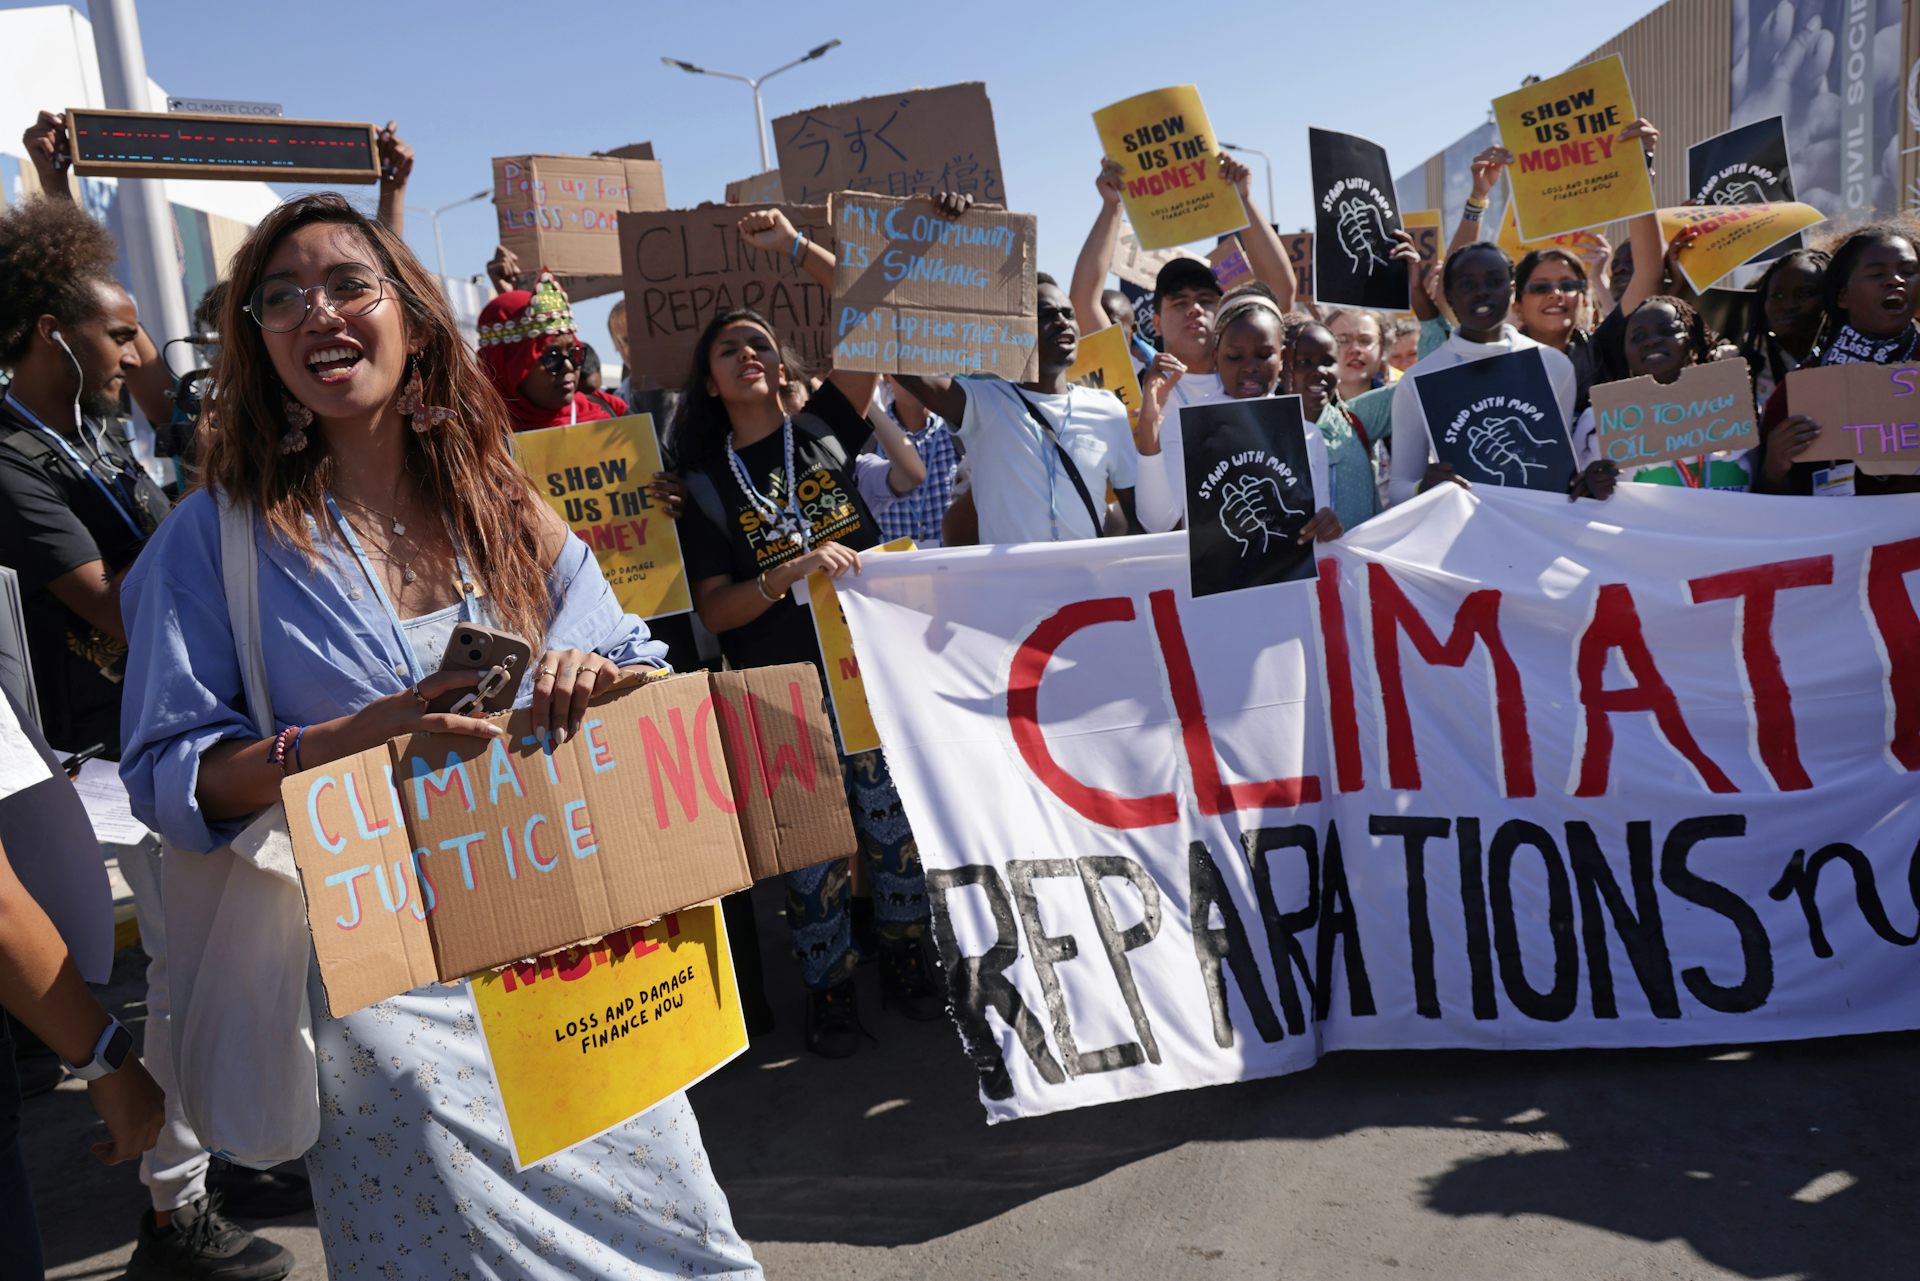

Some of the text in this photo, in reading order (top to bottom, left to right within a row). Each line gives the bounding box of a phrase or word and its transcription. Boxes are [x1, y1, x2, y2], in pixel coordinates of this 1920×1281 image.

[187, 102, 278, 115] CLIMATE CLOCK
[1520, 88, 1595, 127] SHOW
[1535, 104, 1621, 143] US THE
[787, 99, 910, 176] 今すぐ
[1122, 115, 1185, 153] SHOW
[1137, 134, 1208, 171] US THE
[1518, 133, 1615, 173] MONEY
[1126, 158, 1208, 199] MONEY
[1847, 113, 1864, 209] CIVIL
[559, 177, 585, 201] up
[1322, 178, 1393, 219] STAND WITH MAPA
[1541, 170, 1620, 196] LOSS AND DAMAGE
[1552, 182, 1612, 201] FINANCE NOW
[1696, 162, 1778, 206] STAND WITH MAPA
[843, 202, 1016, 257] MY COMMUNITY
[839, 240, 991, 289] IS SINKING
[838, 306, 881, 337] PAY
[961, 321, 998, 344] THE
[837, 339, 879, 360] AND
[1839, 336, 1872, 357] Loss
[1444, 396, 1544, 444] STAND WITH MAPA
[1600, 404, 1644, 436] NO
[1652, 402, 1685, 424] TO
[1607, 434, 1661, 462] OIL
[1666, 428, 1704, 452] AND
[546, 458, 627, 497] SHOW
[1198, 450, 1298, 500] STAND WITH MAPA
[564, 485, 656, 523] US THE
[575, 517, 648, 553] ONEY
[619, 560, 655, 575] DAMAGE
[627, 572, 647, 584] NOW
[638, 681, 817, 831] NOW
[306, 717, 616, 855] CLIMATE
[325, 800, 601, 931] JUSTICE
[926, 814, 1920, 1100] REPARATIONS n
[555, 965, 695, 1042] LOSS AND DAMAGE
[581, 993, 684, 1054] FINANCE NOW
